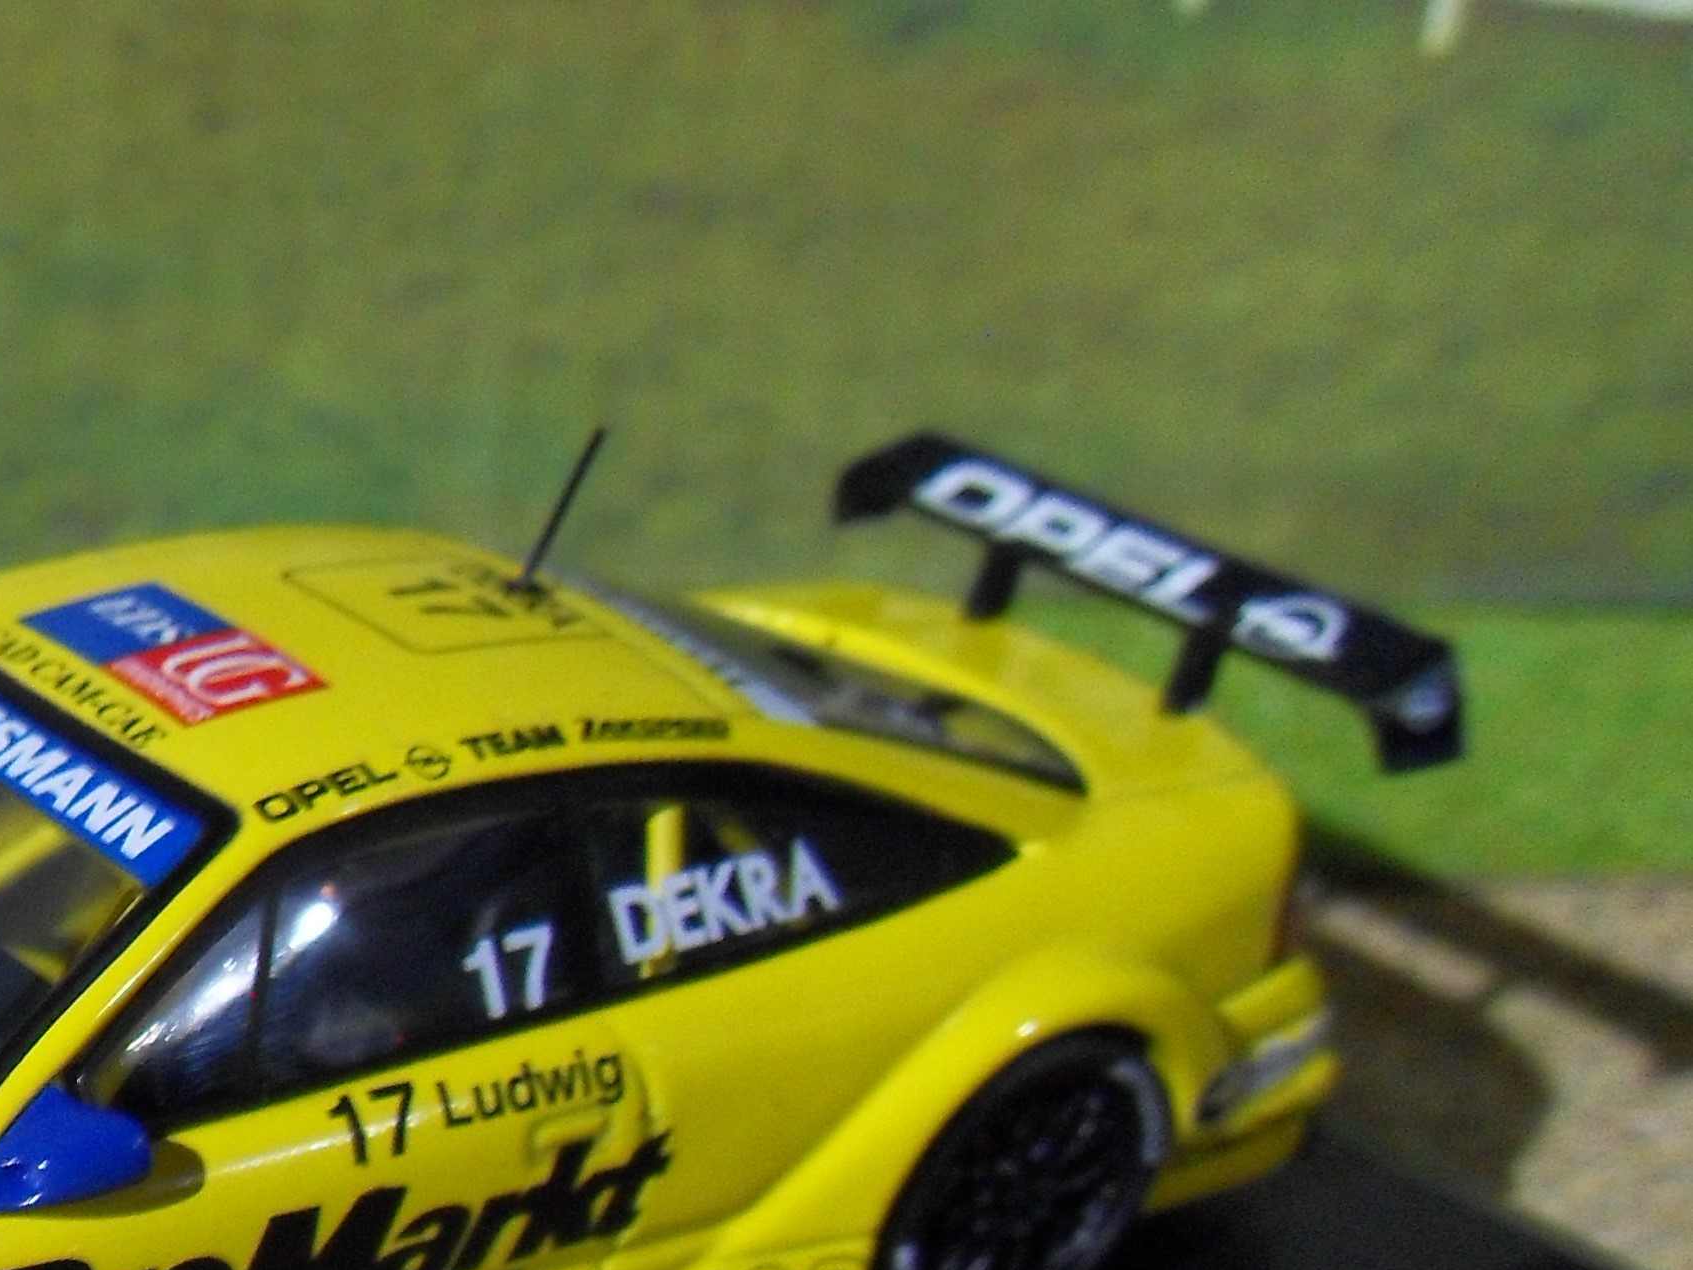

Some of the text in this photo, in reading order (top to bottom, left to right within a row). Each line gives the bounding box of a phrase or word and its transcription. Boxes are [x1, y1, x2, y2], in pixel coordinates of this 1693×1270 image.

[913, 456, 1222, 626] OPEL
[255, 761, 401, 823] OPEL
[461, 836, 843, 1020] 17 DEKRA
[325, 1048, 625, 1168] 17 Ludwig
